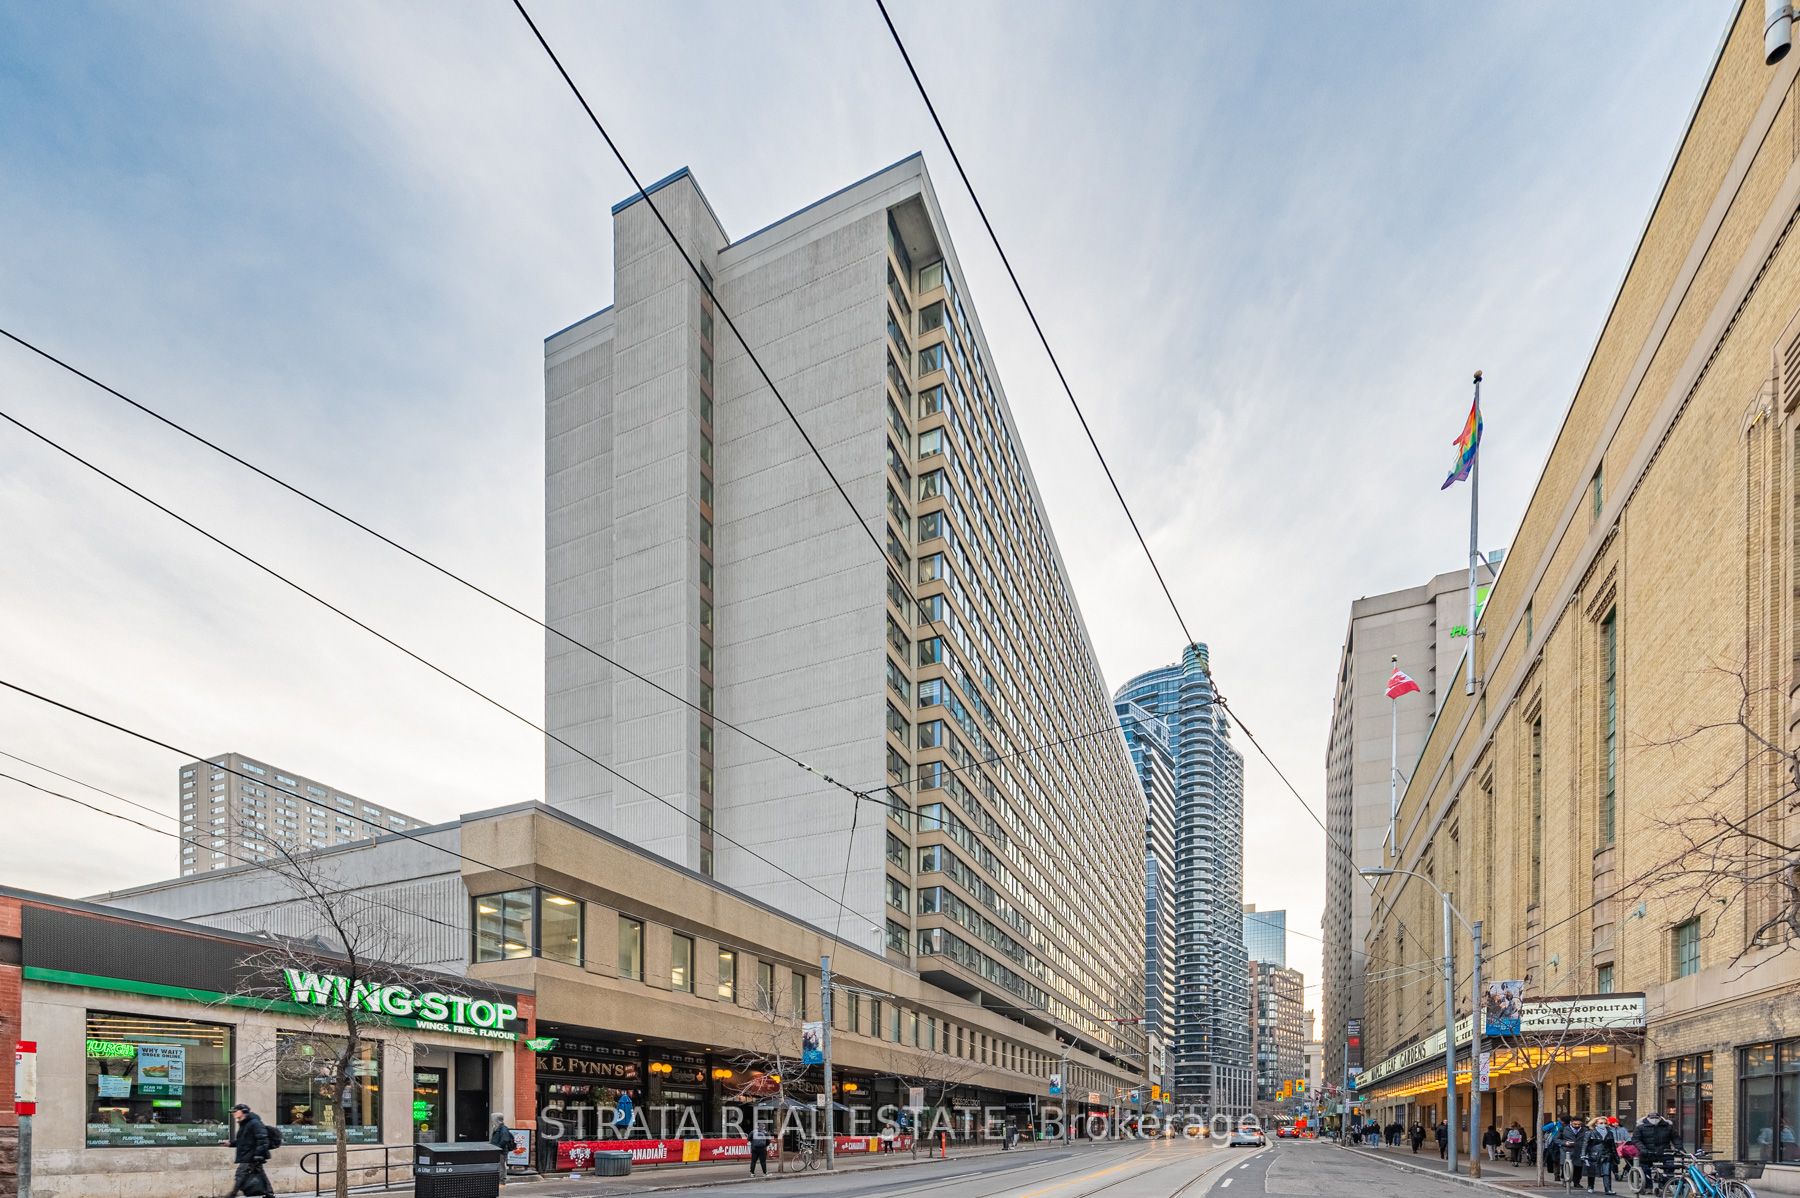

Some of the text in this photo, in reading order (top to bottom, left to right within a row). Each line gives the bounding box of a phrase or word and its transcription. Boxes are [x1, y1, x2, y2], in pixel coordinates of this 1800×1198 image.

[1552, 1003, 1638, 1014] METROPOLITAN
[1529, 1016, 1605, 1026] UNIVERSITY
[416, 1020, 515, 1041] WINGS. FRIES. FLAVOUR
[1385, 1057, 1396, 1074] LEAF
[1400, 1041, 1427, 1066] GARDENS
[569, 1058, 625, 1076] FYNN'S
